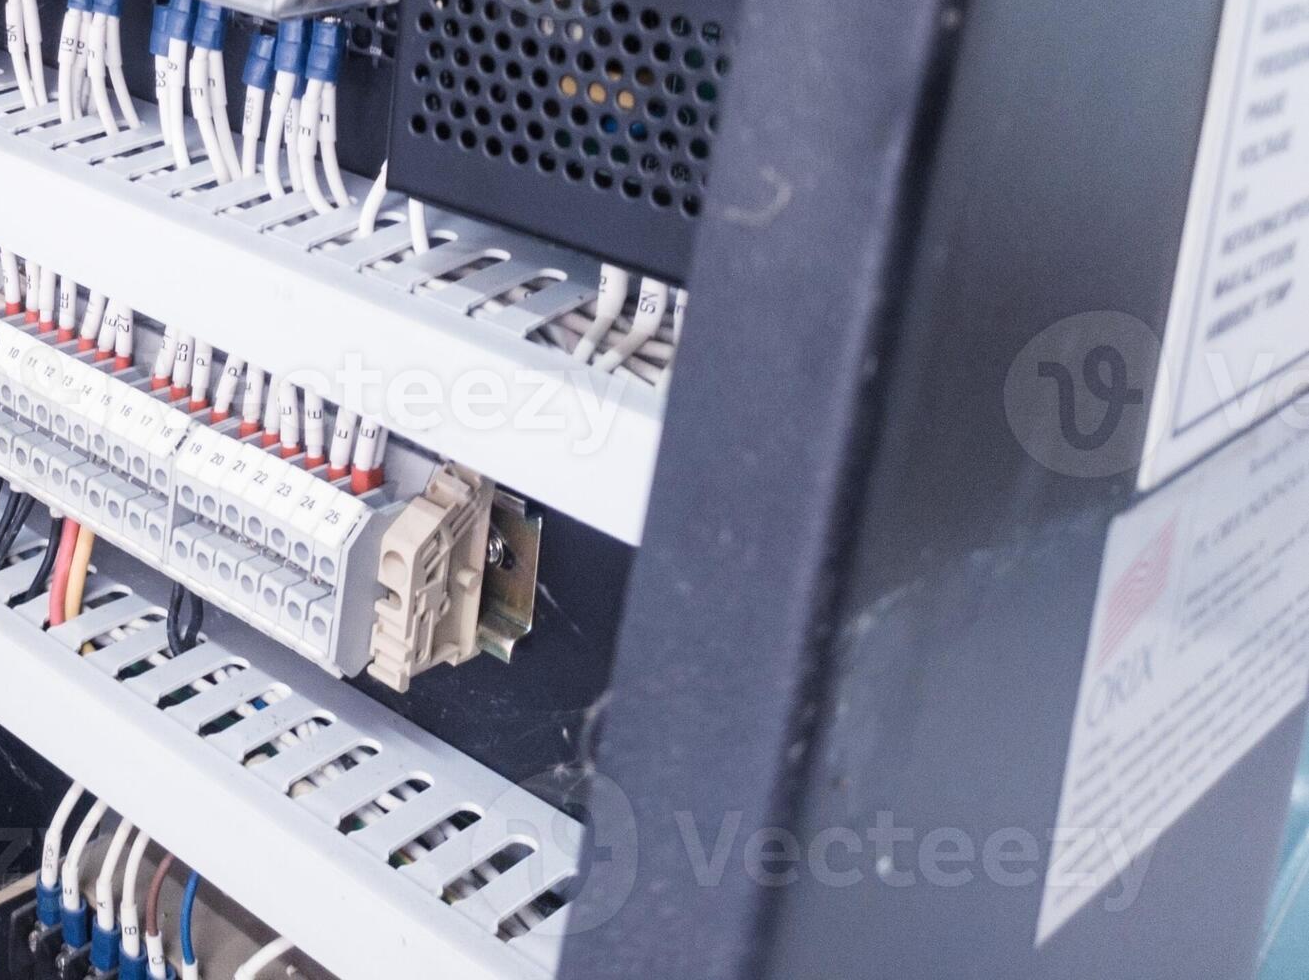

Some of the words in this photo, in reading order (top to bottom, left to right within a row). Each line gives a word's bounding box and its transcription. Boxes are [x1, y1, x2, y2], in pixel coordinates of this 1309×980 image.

[245, 97, 254, 125] STOP
[117, 314, 130, 333] 27
[177, 342, 189, 362] ES
[9, 346, 20, 359] 10
[28, 357, 38, 368] 11
[44, 365, 55, 377] 12
[62, 375, 73, 387] 13
[81, 384, 92, 396] 14
[100, 393, 111, 406] 15
[120, 404, 132, 417] 16
[141, 414, 153, 427] 17
[160, 425, 173, 438] 18
[308, 409, 322, 420] E
[335, 428, 348, 439] E
[361, 426, 375, 439] E
[191, 442, 203, 454] 19
[210, 453, 225, 466] 20
[233, 460, 246, 473] 21
[253, 470, 269, 485] 22
[277, 483, 292, 498] 23
[300, 496, 316, 511] 24
[325, 509, 341, 525] 25
[124, 925, 137, 935] B
